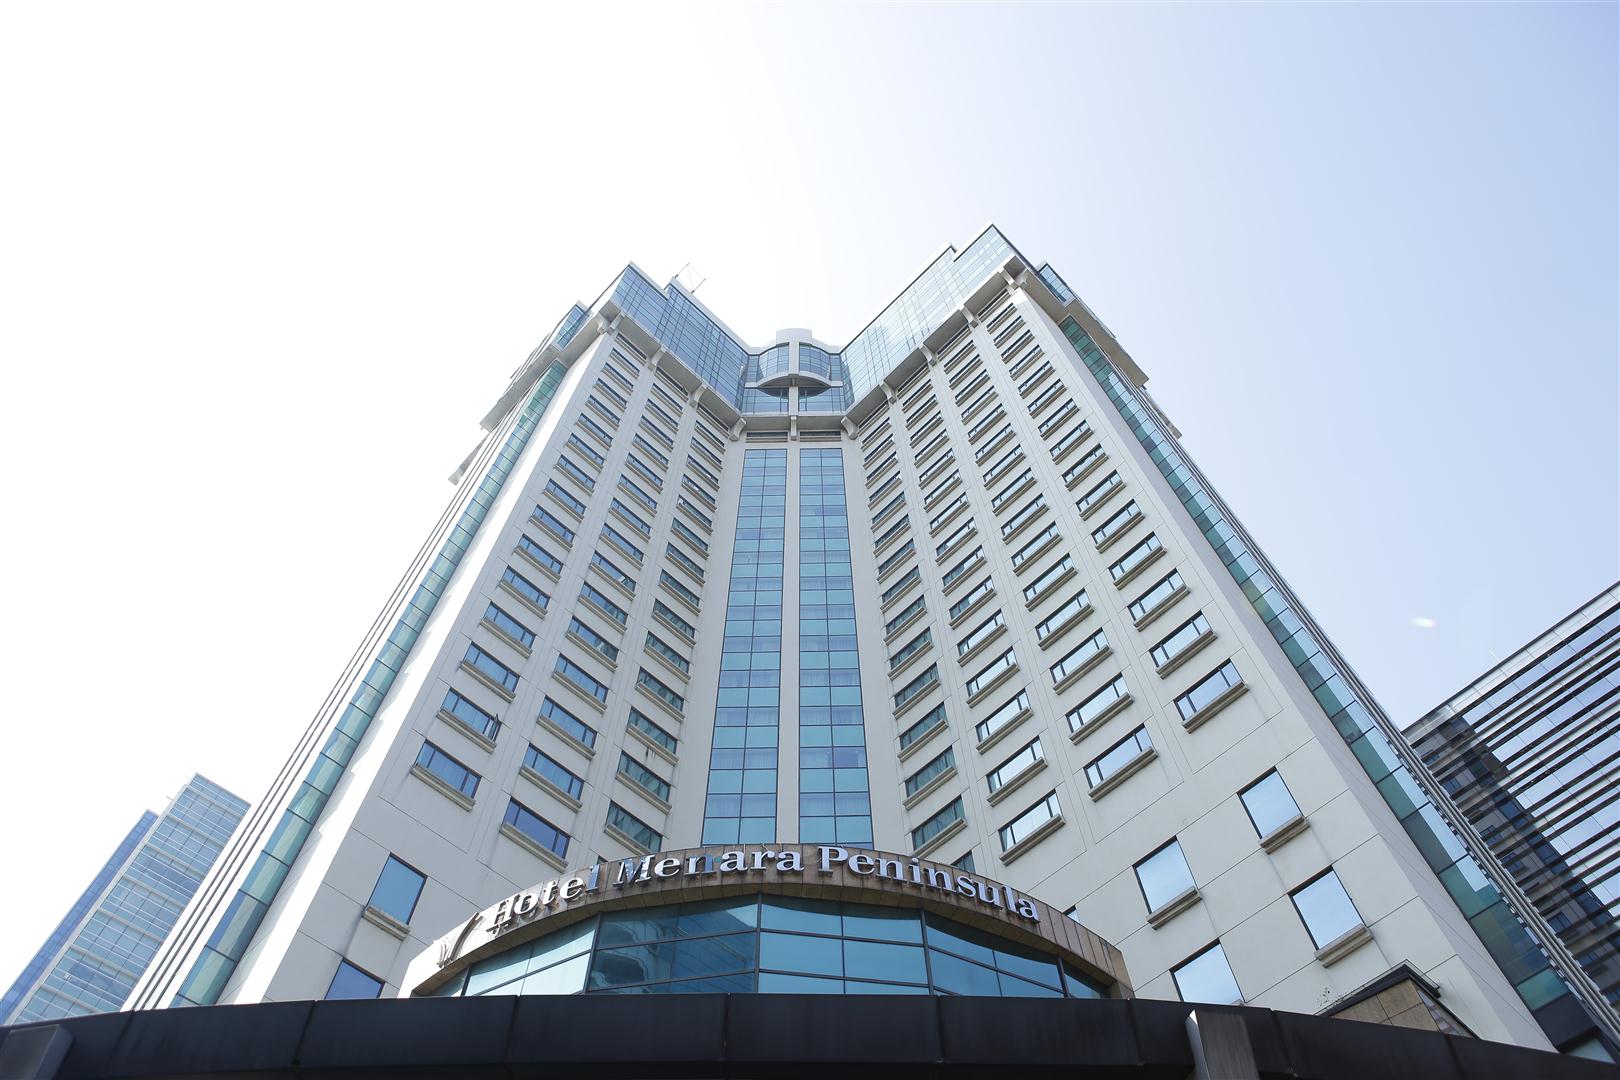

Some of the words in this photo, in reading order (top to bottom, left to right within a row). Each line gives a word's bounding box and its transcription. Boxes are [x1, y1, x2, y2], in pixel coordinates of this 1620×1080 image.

[485, 864, 600, 933] Hotel
[613, 850, 804, 886] Menara
[817, 846, 1039, 921] Peninsula
